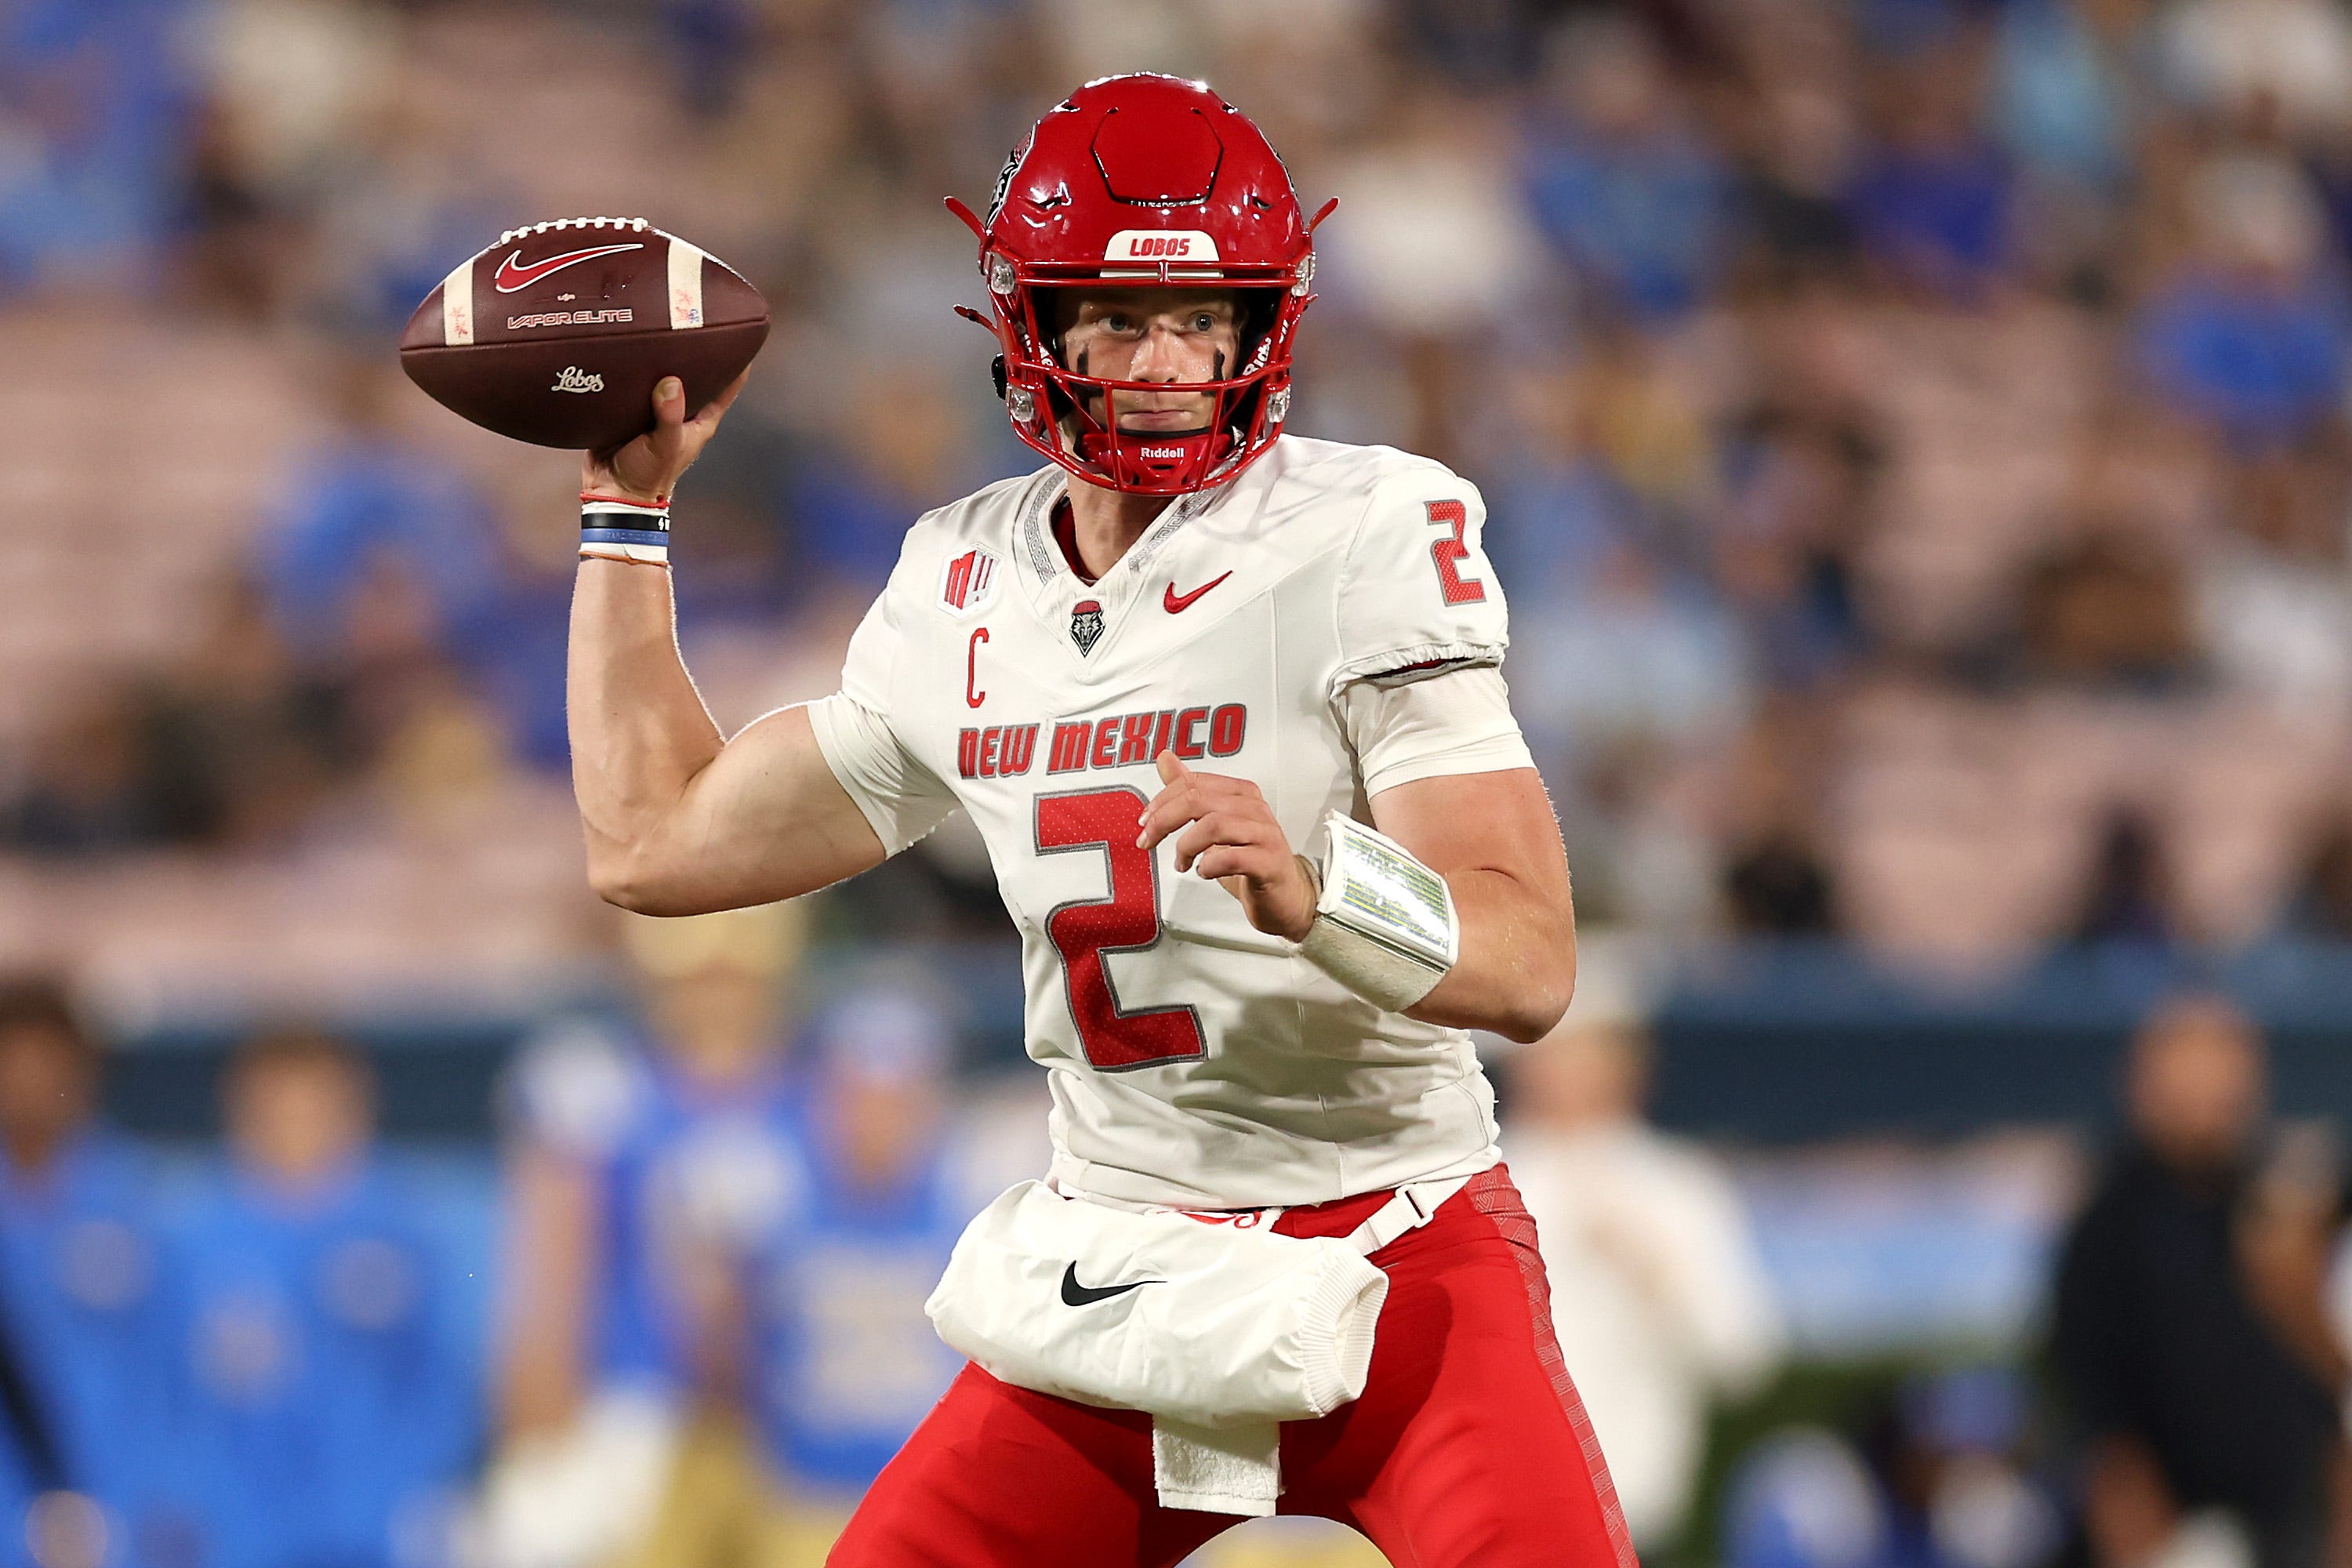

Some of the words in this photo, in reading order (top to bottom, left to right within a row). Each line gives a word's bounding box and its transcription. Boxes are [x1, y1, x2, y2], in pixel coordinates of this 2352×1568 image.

[1130, 238, 1190, 256] LOBOS
[507, 312, 572, 329] VAPOR
[574, 309, 633, 324] ELITE
[551, 366, 604, 393] Lobos
[1141, 447, 1184, 458] Riddell
[1423, 499, 1487, 607] 2
[967, 627, 989, 708] C
[957, 723, 1040, 779] NEW
[1046, 702, 1247, 775] MEXICO
[1033, 784, 1208, 1073] 2
